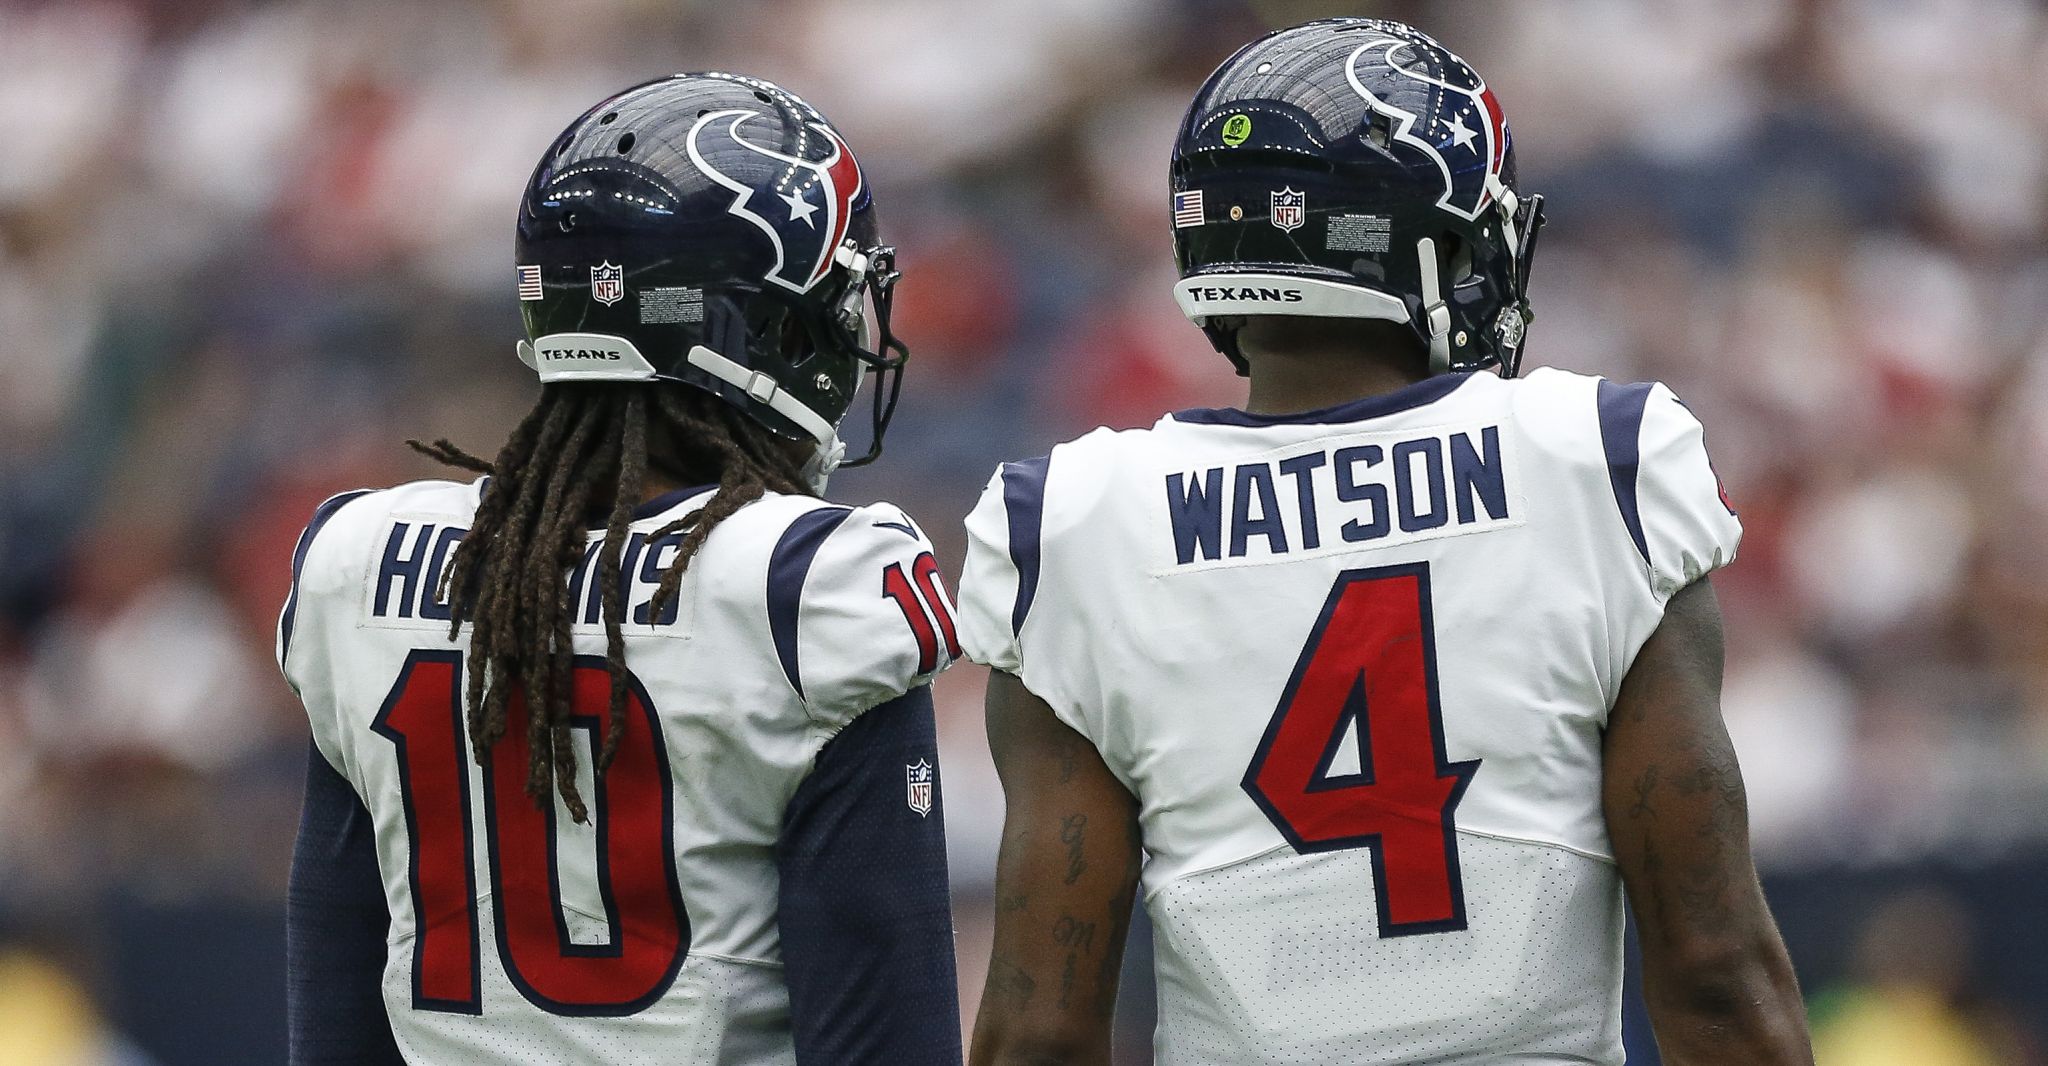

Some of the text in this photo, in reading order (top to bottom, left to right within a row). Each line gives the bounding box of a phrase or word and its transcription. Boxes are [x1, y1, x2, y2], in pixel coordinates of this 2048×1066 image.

[1276, 212, 1299, 226] NFL
[597, 282, 620, 297] NFL
[1188, 287, 1302, 302] TEXANS
[542, 349, 620, 360] TEXANS
[1165, 425, 1510, 565] WATSON
[373, 522, 689, 626] HOINS
[883, 551, 962, 676] 10
[1239, 560, 1483, 939] 4
[370, 649, 692, 1018] 10
